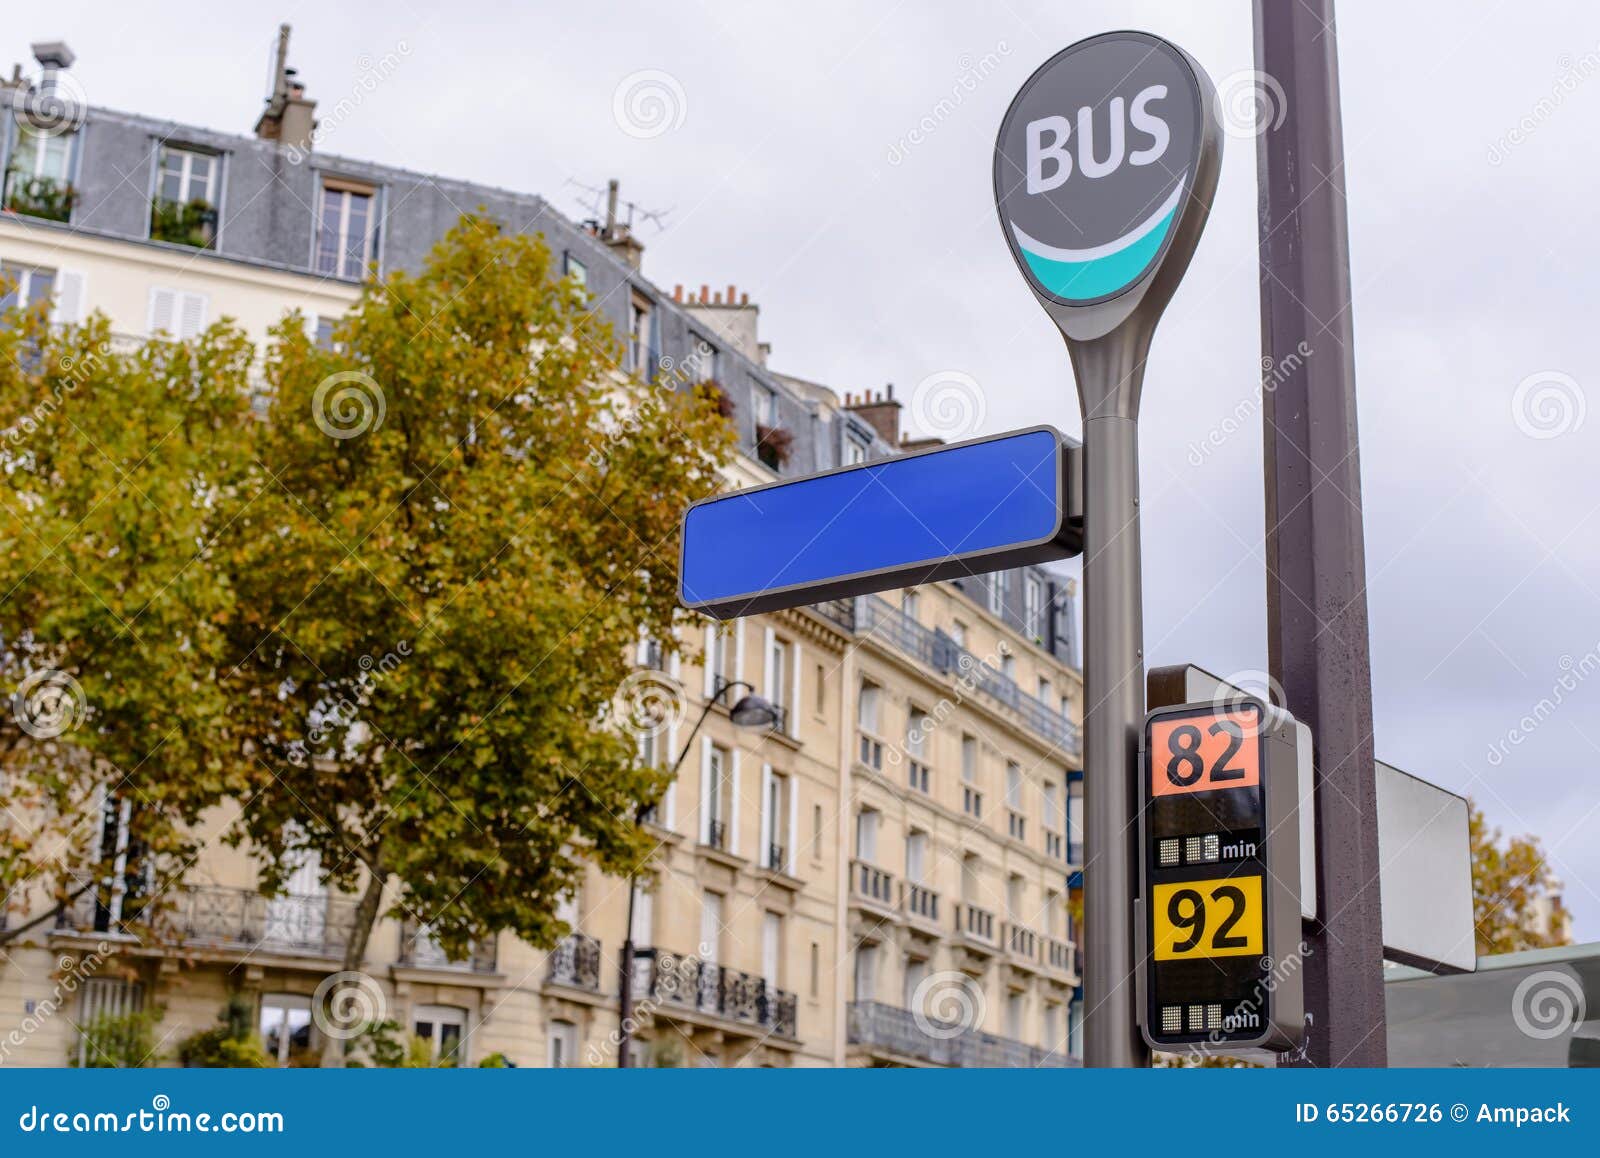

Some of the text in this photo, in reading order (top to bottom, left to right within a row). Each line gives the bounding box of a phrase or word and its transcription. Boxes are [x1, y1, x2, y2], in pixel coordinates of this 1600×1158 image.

[1026, 84, 1170, 195] BUS
[1166, 719, 1246, 787] 82
[1222, 840, 1256, 858] min
[1167, 885, 1248, 953] 92
[1225, 1009, 1260, 1029] min
